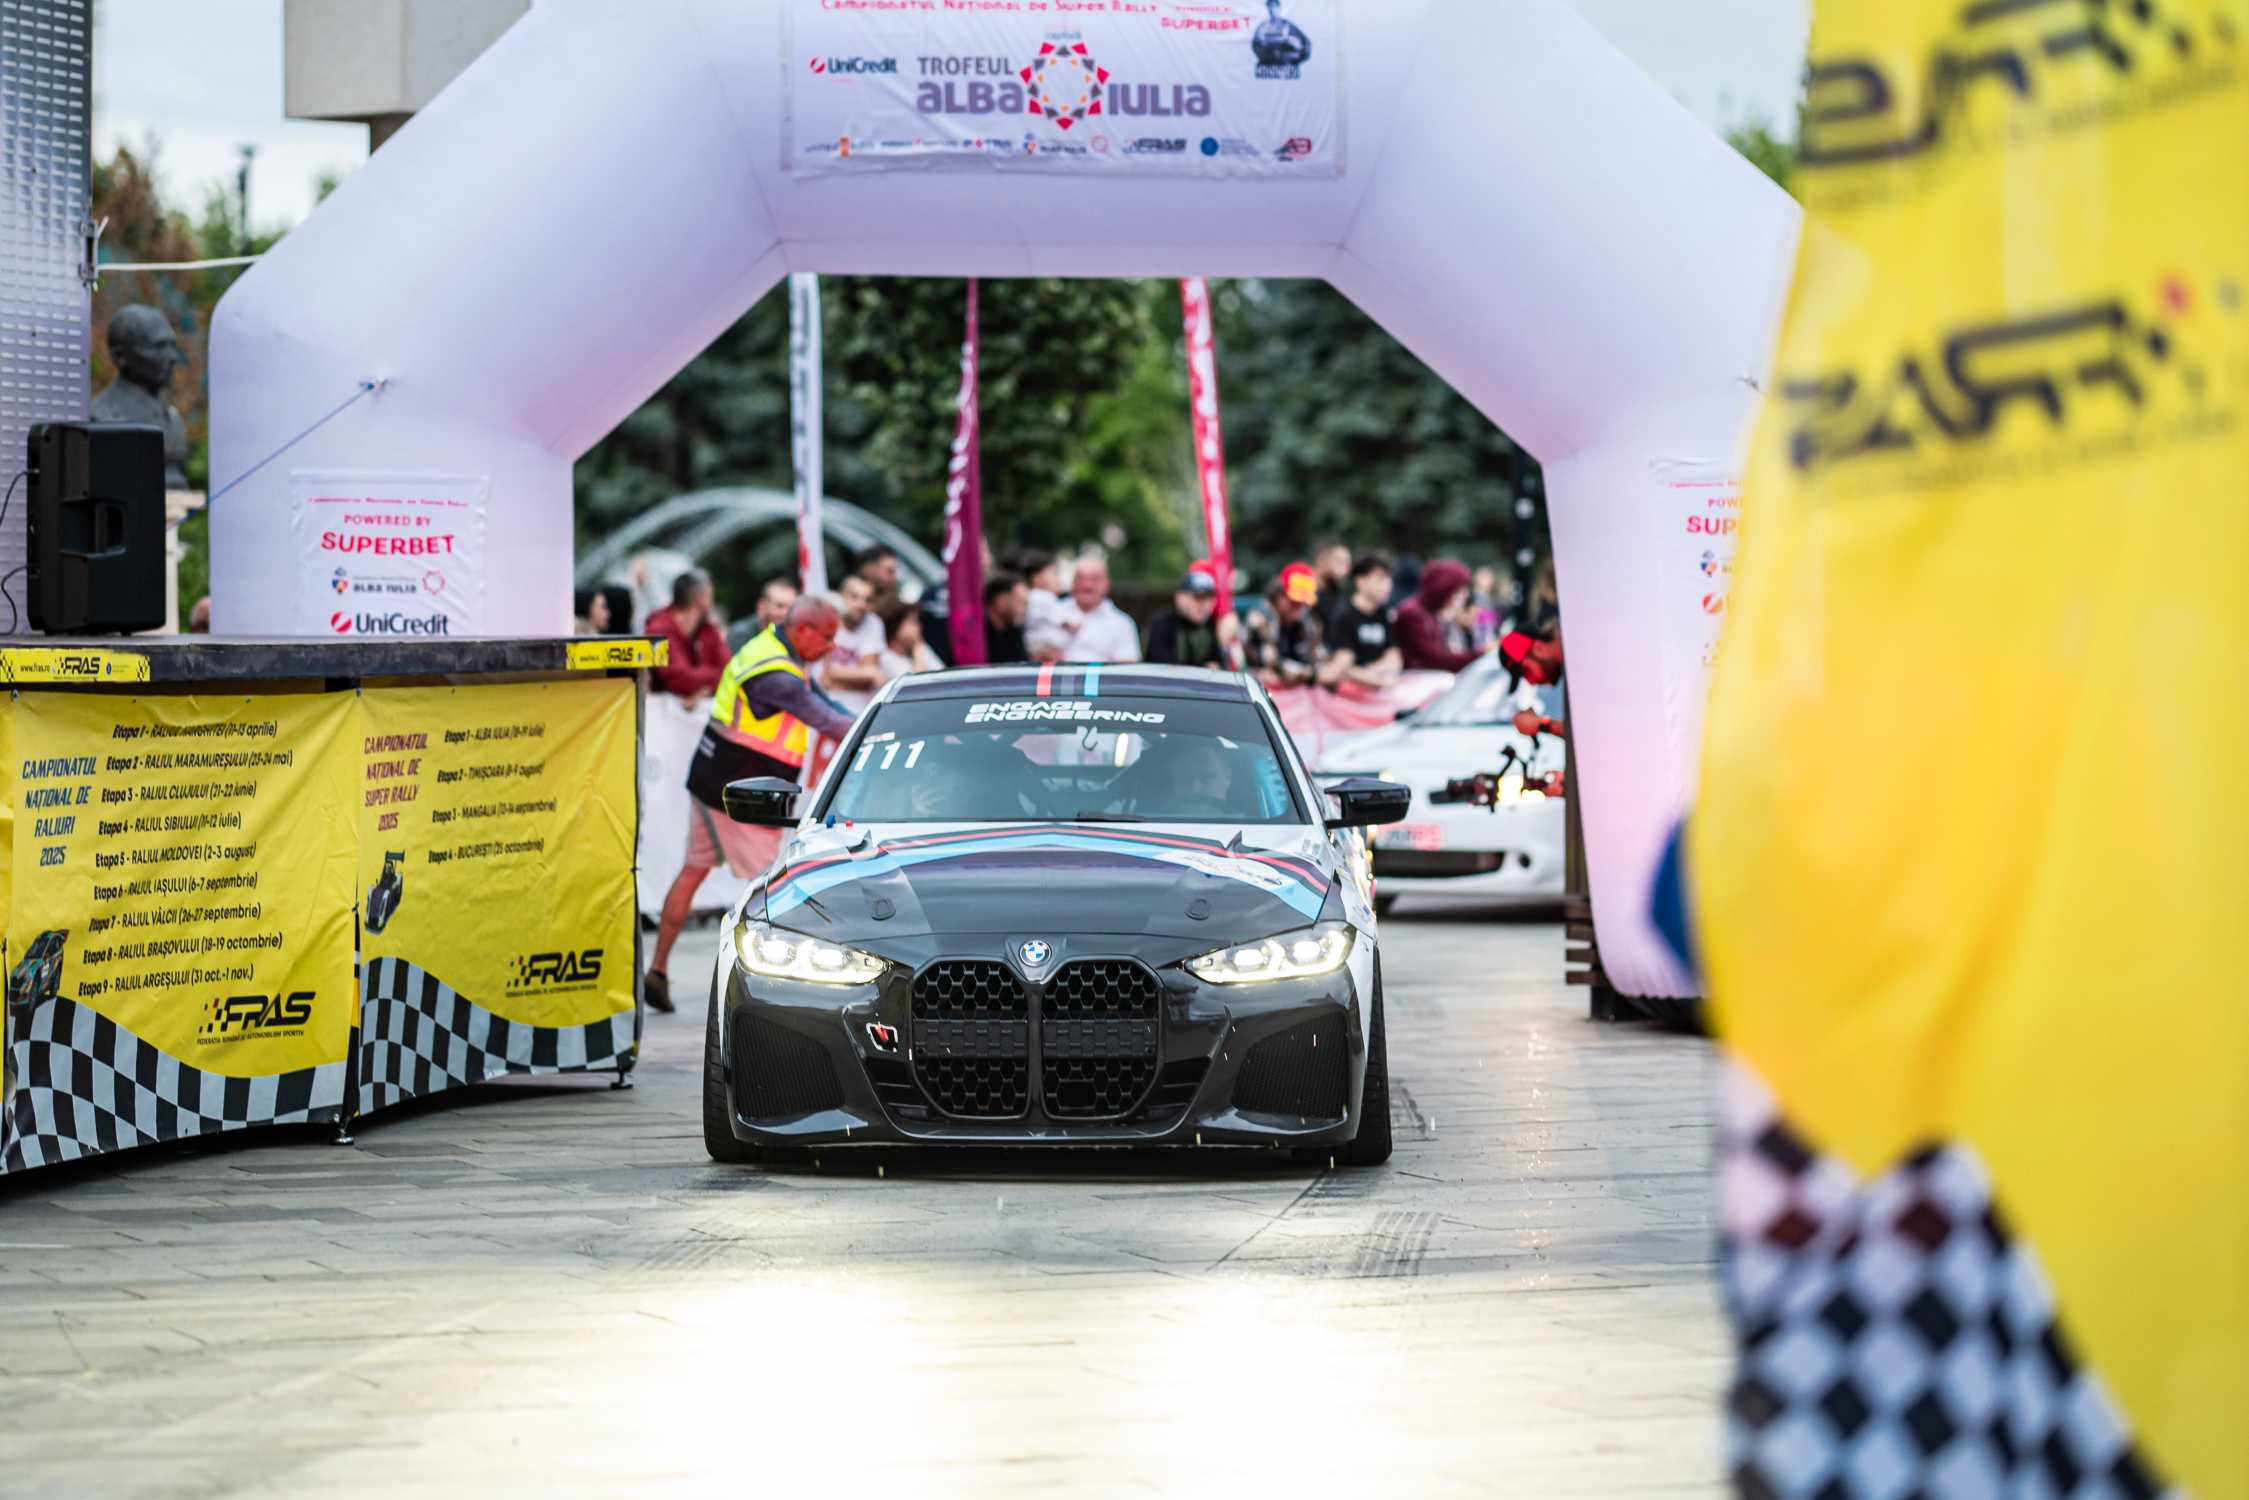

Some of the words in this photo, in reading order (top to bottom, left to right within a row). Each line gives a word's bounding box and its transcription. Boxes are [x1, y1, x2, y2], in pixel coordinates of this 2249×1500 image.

[827, 57, 898, 74] UniCredit
[917, 57, 1014, 75] TROFEUL
[343, 514, 411, 526] POWERED
[415, 515, 431, 526] BY
[321, 531, 455, 555] SUPERBET
[356, 612, 448, 635] UniCredit
[63, 657, 100, 674] FRAS
[965, 710, 1165, 724] ENGINEERING
[969, 701, 1092, 713] ENGAGE
[112, 725, 139, 741] Etapa
[246, 721, 278, 740] aprilie)
[364, 733, 428, 754] CAMPIONATUL
[106, 756, 135, 774] Etapa
[145, 754, 172, 769] RALIUL
[273, 749, 293, 768] mai)
[408, 758, 422, 776] DE
[854, 741, 925, 771] 111
[22, 757, 97, 779] CAMPIONATUL
[76, 786, 92, 805] DE
[101, 788, 126, 806] Etapa
[140, 786, 167, 800] RALIUL
[169, 783, 209, 800] CLUJULUI
[233, 781, 257, 799] iunie)
[365, 788, 390, 808] SUPER
[390, 784, 420, 803] RALLY
[34, 815, 76, 838] RALIURI
[98, 820, 123, 837] Etapa
[134, 817, 162, 833] RALIUL
[164, 815, 199, 831] SIBIULUI
[218, 811, 241, 830] iulie)
[40, 846, 67, 867] 2025
[95, 852, 119, 870] Etapa
[131, 849, 159, 864] RALIUL
[159, 846, 203, 862] MOLDOVEI
[204, 844, 222, 862] (2-3
[224, 841, 257, 862] august)
[94, 885, 118, 902] Etapa
[128, 880, 153, 896] RALIUL
[188, 875, 205, 894] (6-7
[206, 871, 258, 893] septembrie)
[122, 912, 150, 929] RALIUL
[203, 902, 262, 923] septembrie)
[83, 949, 107, 966] Etapa
[118, 943, 146, 960] RALIUL
[201, 936, 224, 954] (18-19
[226, 932, 283, 950] octombrie)
[524, 948, 604, 986] FRAS
[78, 982, 102, 999] Etapa
[115, 976, 142, 992] RALIUL
[191, 968, 203, 986] (31
[230, 964, 254, 980] nov.)
[221, 991, 316, 1033] FRAS
